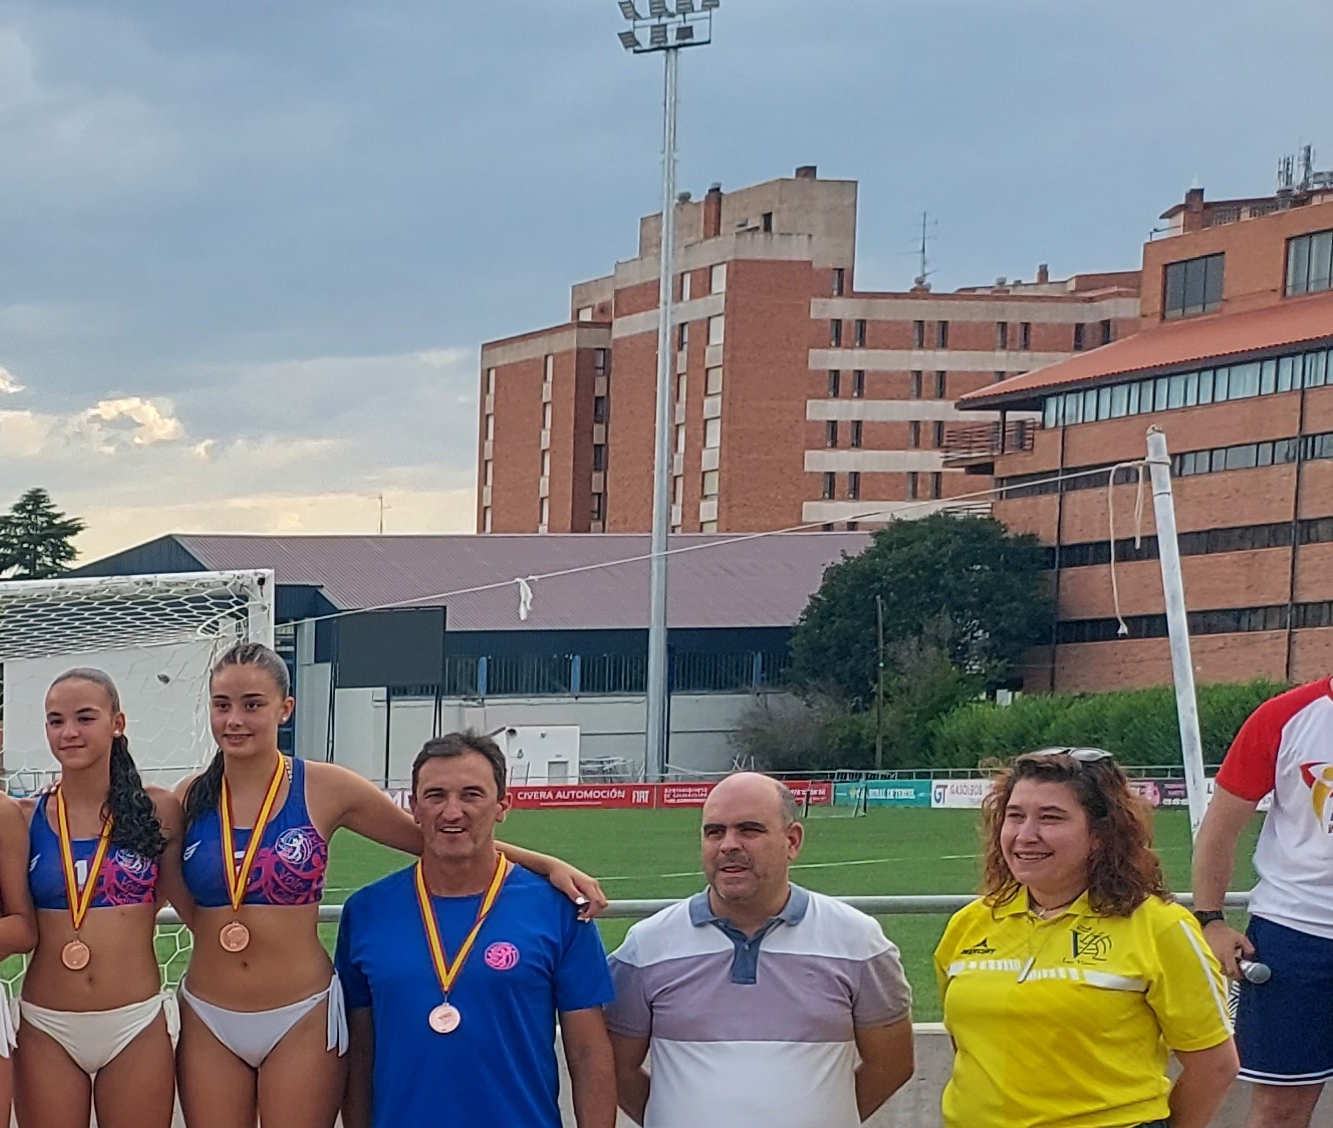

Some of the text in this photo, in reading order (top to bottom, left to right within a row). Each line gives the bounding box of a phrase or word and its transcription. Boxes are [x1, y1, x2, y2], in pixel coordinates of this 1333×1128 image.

[517, 790, 553, 801] CIVERA
[555, 787, 625, 800] AUTOMOCIÓN
[934, 784, 948, 804] GT
